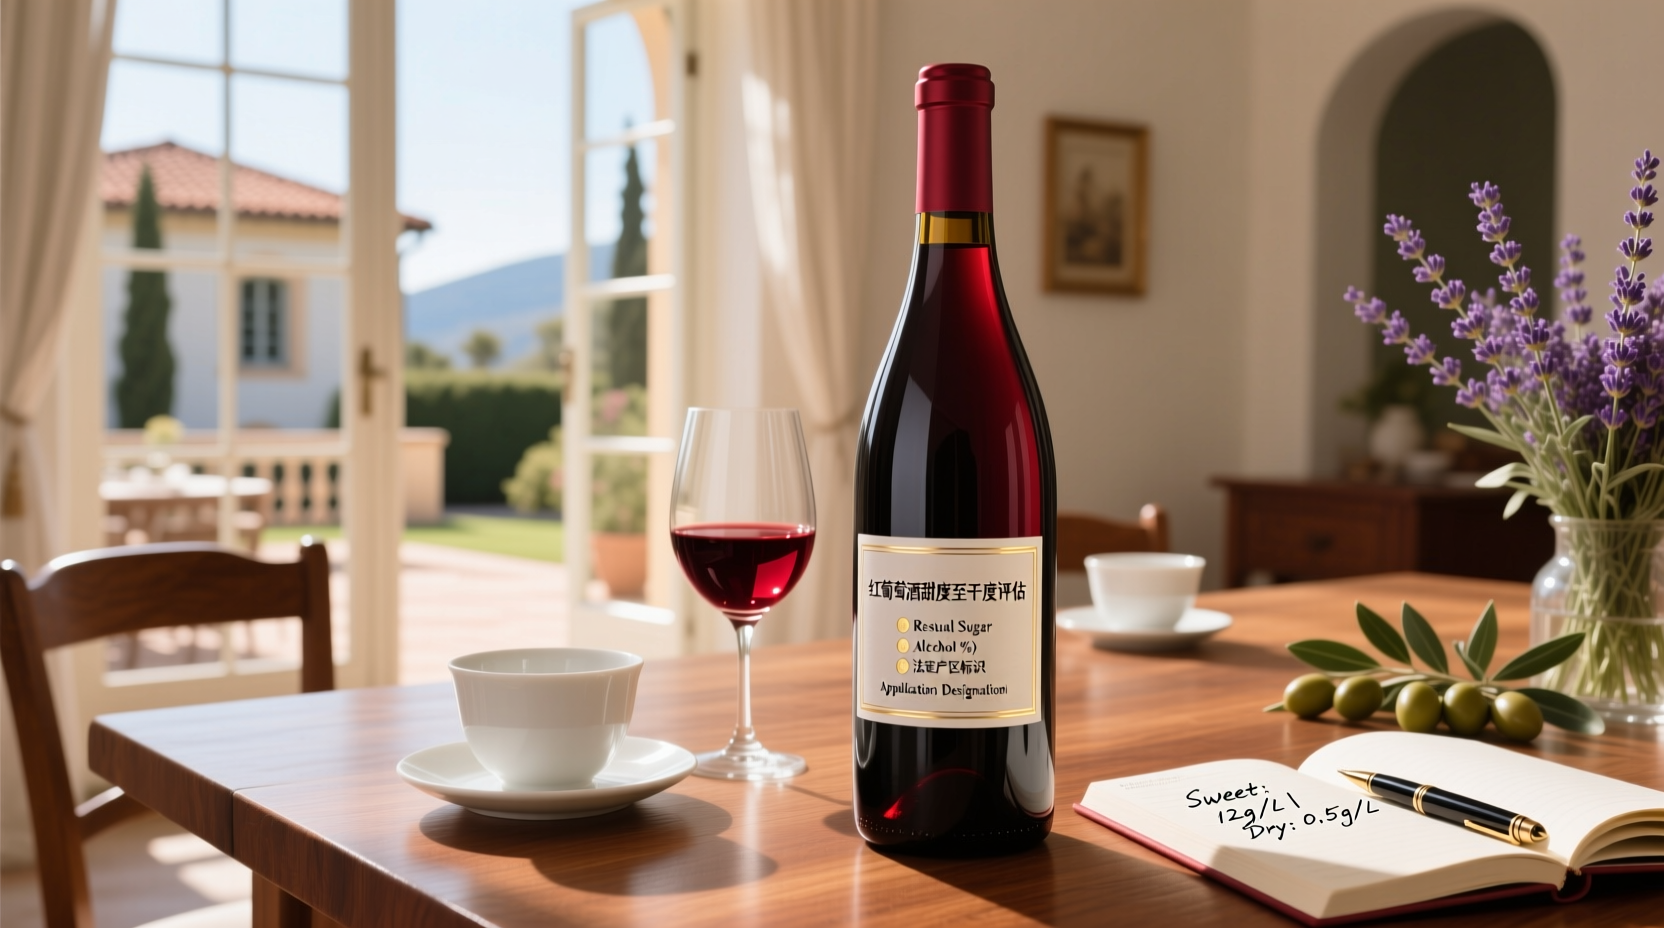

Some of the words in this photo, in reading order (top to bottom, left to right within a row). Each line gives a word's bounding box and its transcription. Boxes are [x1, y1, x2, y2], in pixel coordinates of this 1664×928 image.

[958, 620, 993, 636] Sugar
[1186, 782, 1269, 808] Sweet:
[1218, 797, 1285, 831] 12g/L
[1248, 822, 1296, 841] Dry:
[1303, 799, 1380, 827] 0.5g/L
